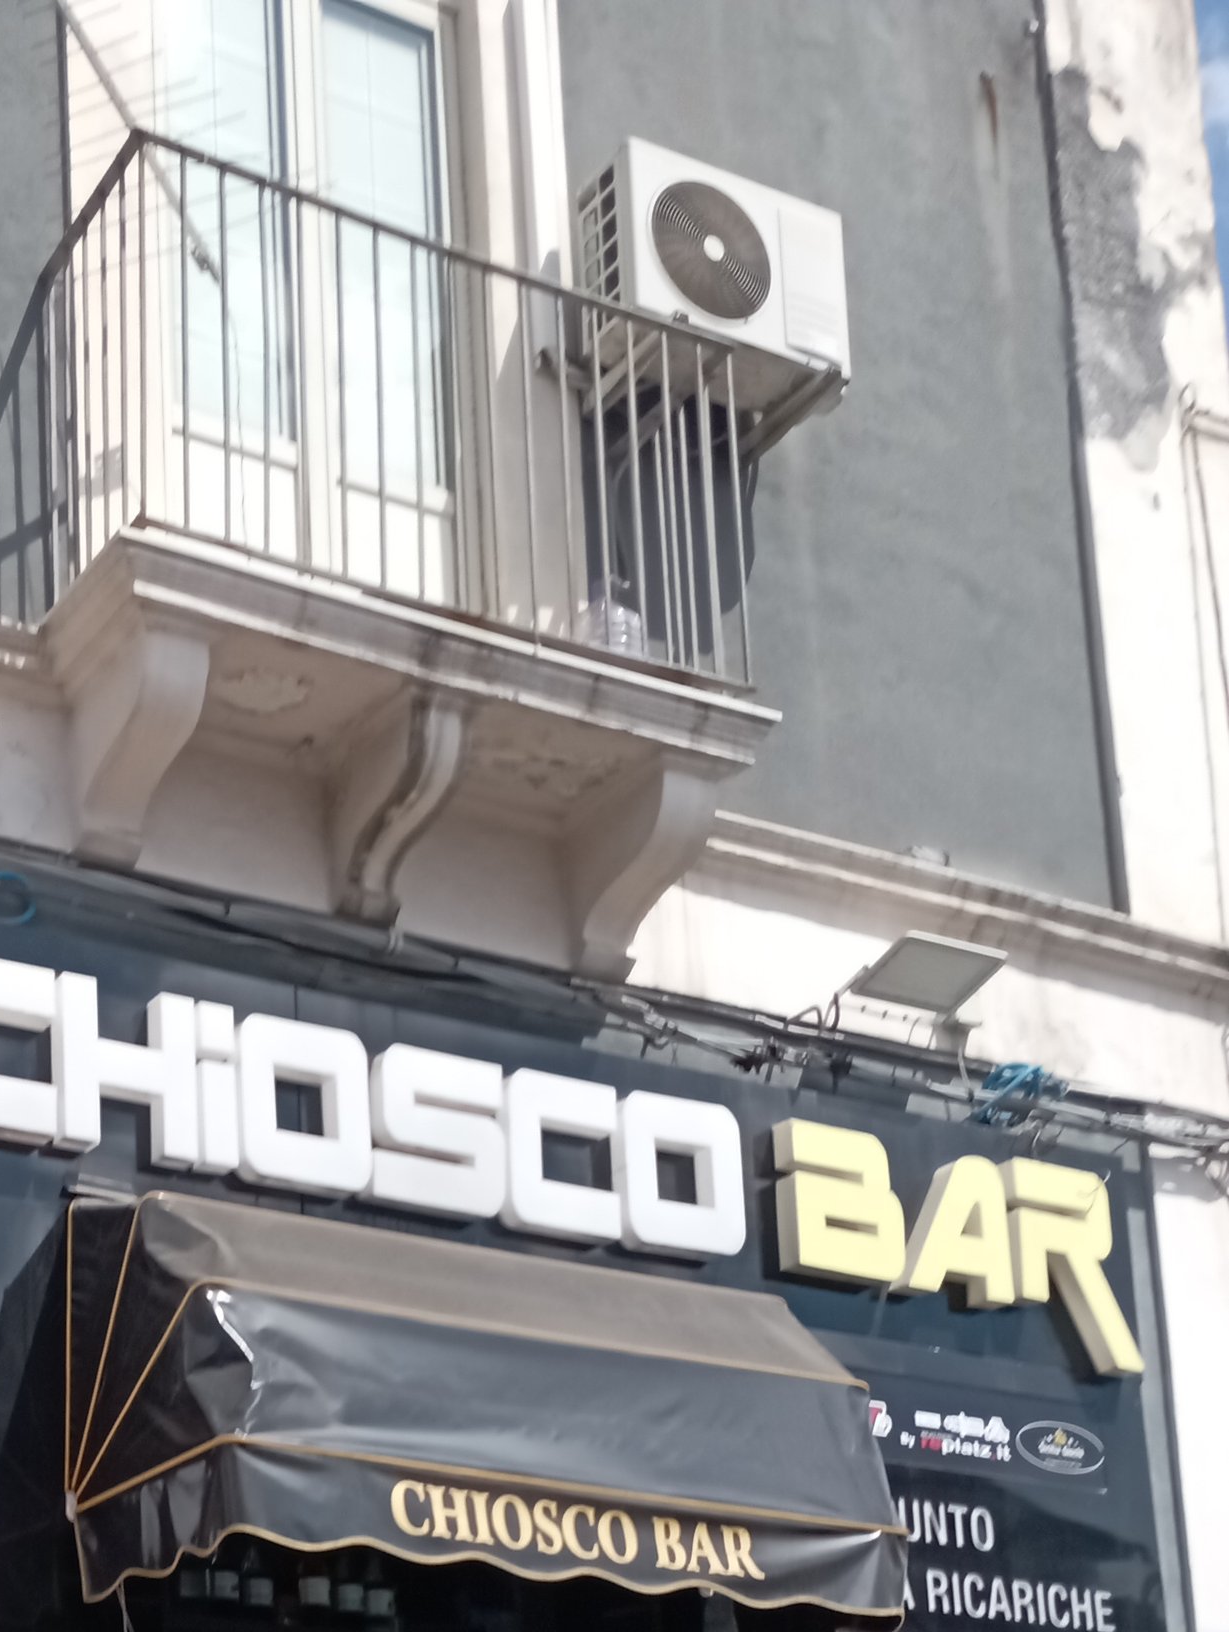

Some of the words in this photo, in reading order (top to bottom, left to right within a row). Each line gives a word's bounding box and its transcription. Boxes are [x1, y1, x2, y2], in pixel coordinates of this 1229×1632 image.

[776, 1117, 1143, 1377] BAR
[390, 1478, 639, 1565] CHIOSCO
[652, 1515, 766, 1580] BAR
[896, 1496, 996, 1552] UNTO
